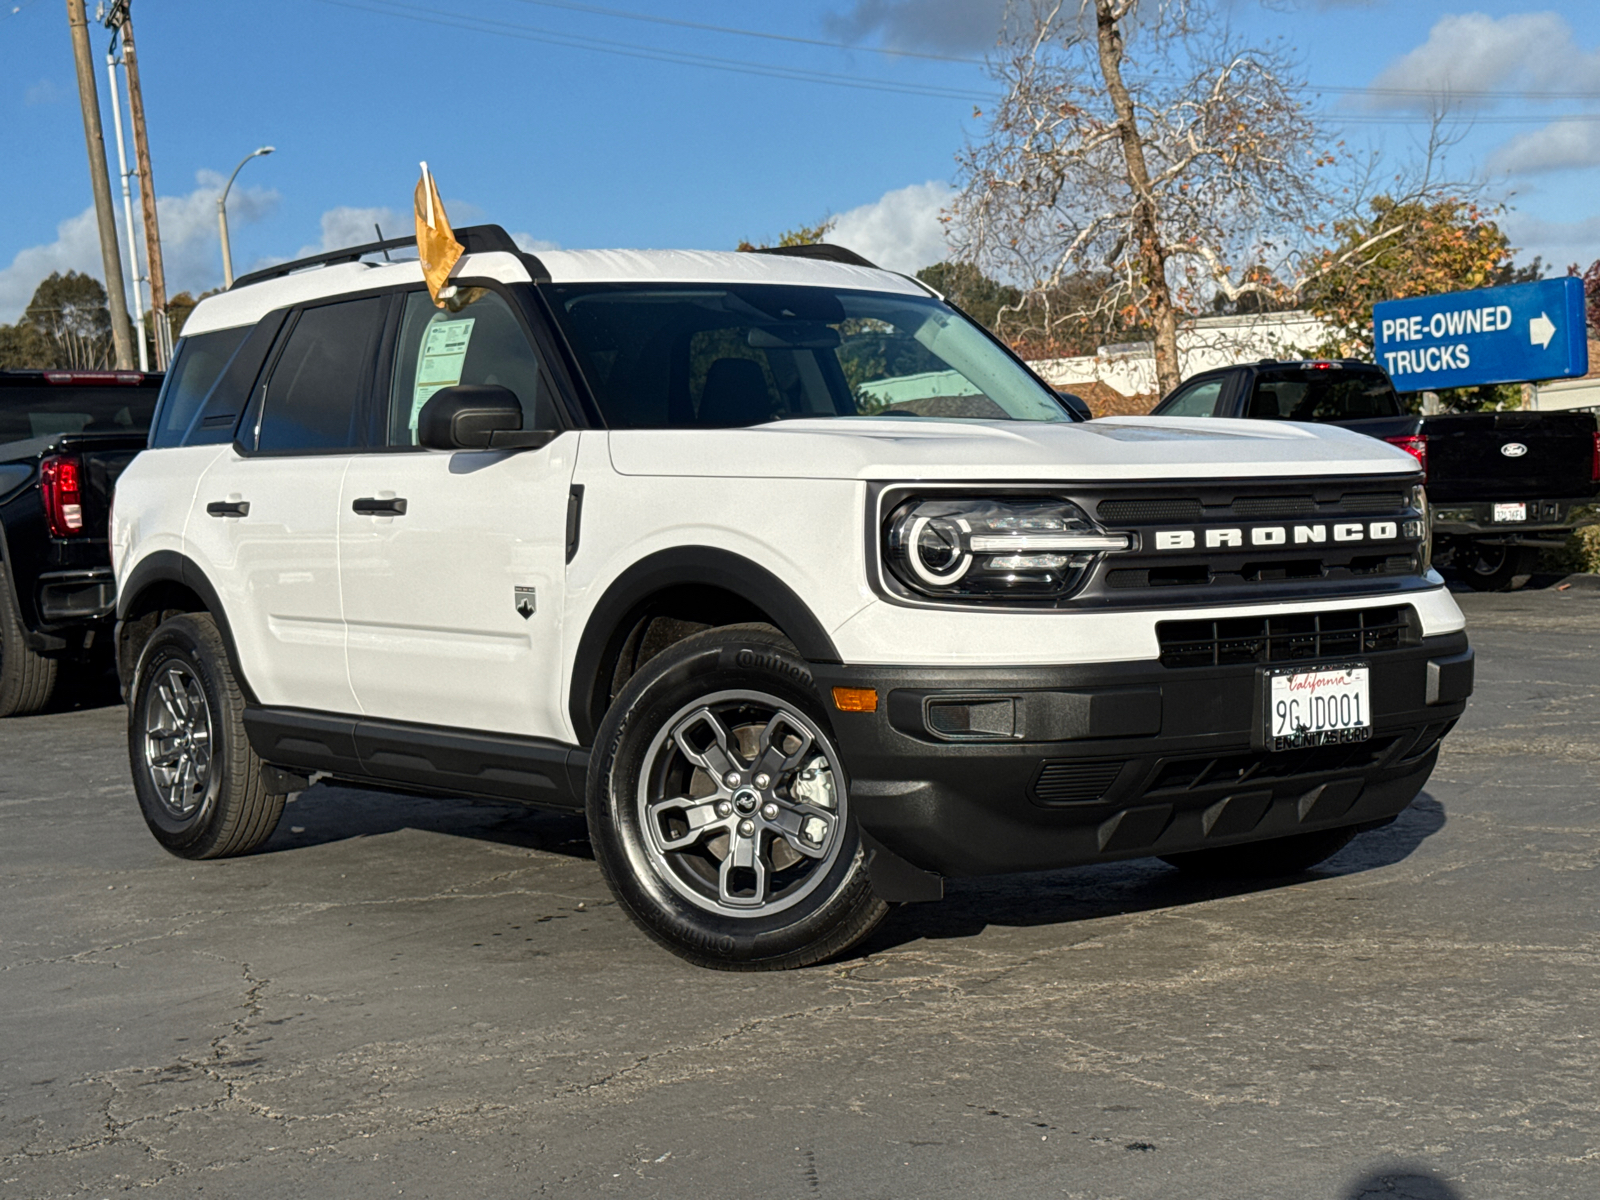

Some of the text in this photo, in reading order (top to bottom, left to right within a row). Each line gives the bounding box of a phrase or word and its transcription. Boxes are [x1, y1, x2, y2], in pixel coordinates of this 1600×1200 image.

[1382, 305, 1512, 344] PRE-OWNED
[1383, 344, 1470, 375] TRUCKS
[1155, 521, 1397, 550] BRONCO
[1289, 673, 1351, 694] California
[1276, 692, 1364, 735] 9GJD001
[1338, 727, 1369, 742] FORD
